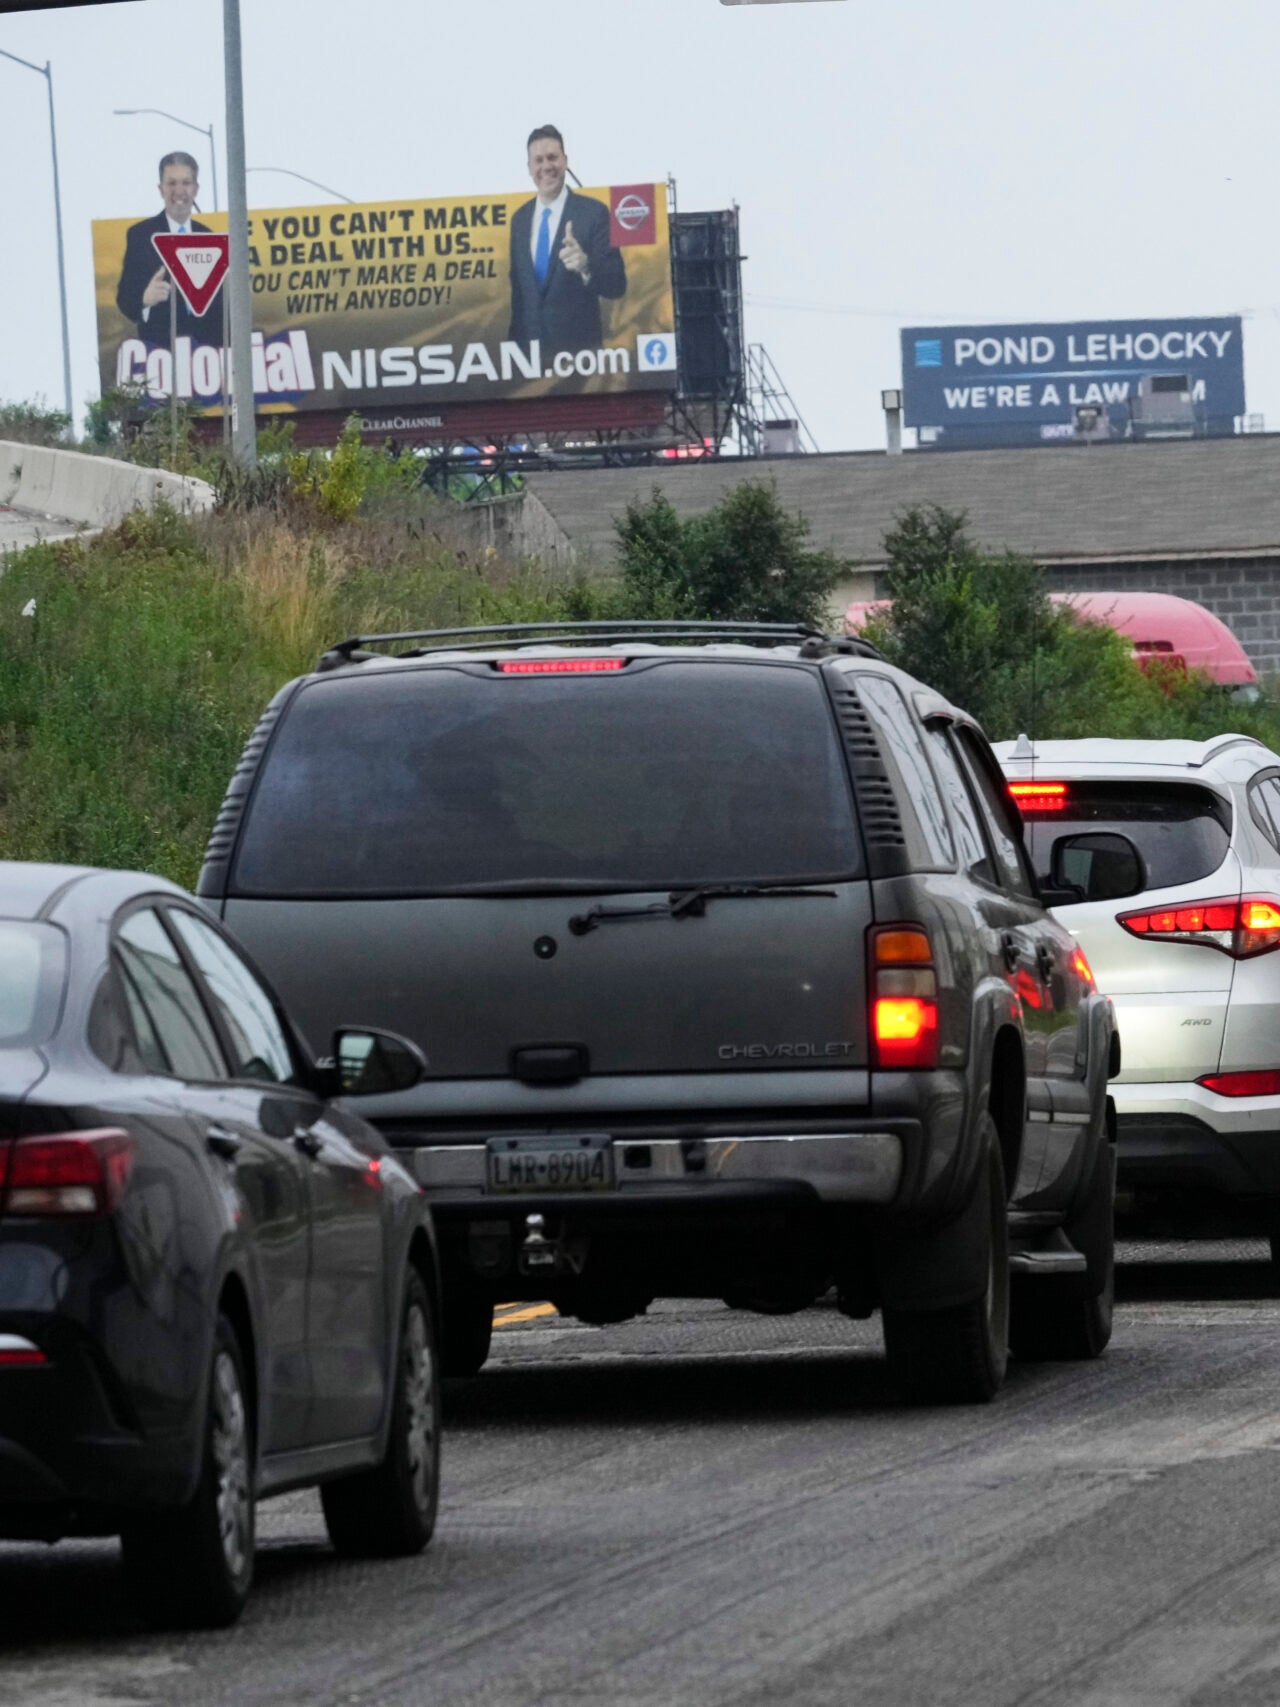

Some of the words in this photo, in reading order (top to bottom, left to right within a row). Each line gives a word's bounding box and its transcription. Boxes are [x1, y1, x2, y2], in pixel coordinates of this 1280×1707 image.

[263, 215, 321, 241] YOU
[329, 209, 415, 236] CAN'T
[424, 204, 507, 230] MAKE
[184, 253, 213, 264] YIELD
[248, 246, 262, 267] A
[270, 240, 344, 266] DEAL
[352, 234, 424, 261] WITH
[434, 232, 494, 256] US...
[249, 271, 282, 294] OU
[288, 267, 351, 291] CAN'T
[356, 263, 417, 286] MAKE
[423, 262, 438, 283] A
[444, 259, 497, 281] DEAL
[286, 292, 338, 315] WITH
[345, 285, 453, 311] ANYBODY!
[953, 335, 1055, 367] POND
[1066, 330, 1232, 363] LEHOCKY
[943, 384, 1033, 409] WE'RE
[1040, 383, 1061, 406] A
[1068, 381, 1130, 405] LAW
[1181, 1018, 1212, 1026] AWD
[718, 1042, 855, 1060] CHEVROLET
